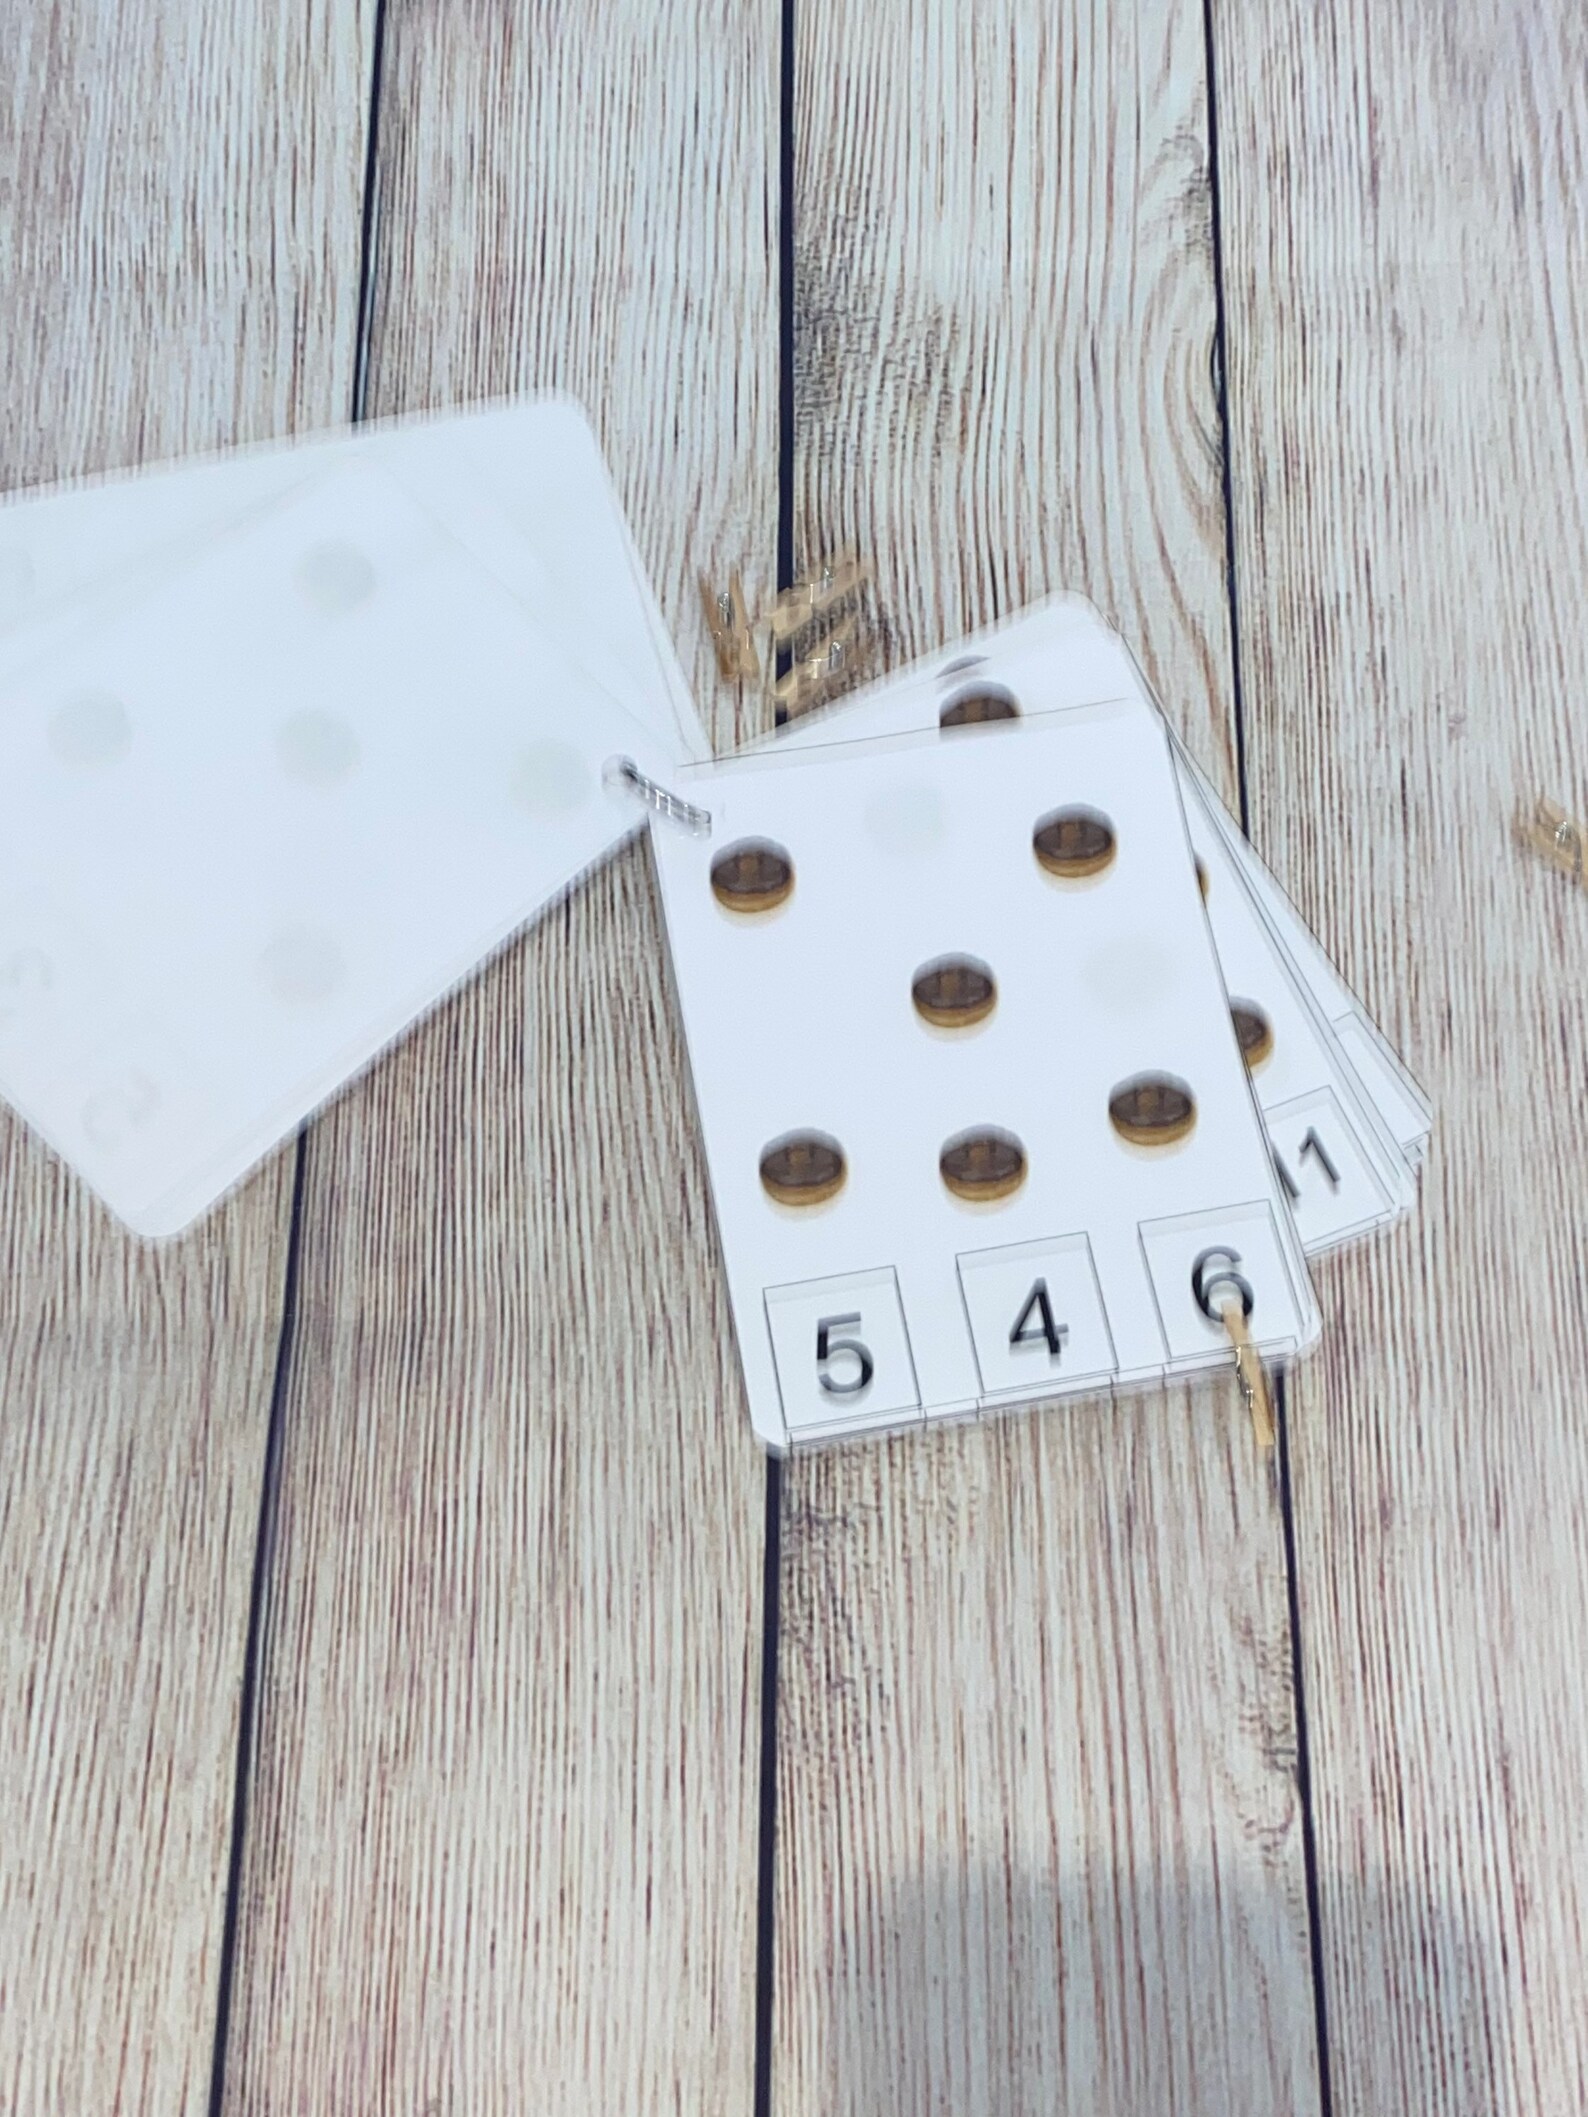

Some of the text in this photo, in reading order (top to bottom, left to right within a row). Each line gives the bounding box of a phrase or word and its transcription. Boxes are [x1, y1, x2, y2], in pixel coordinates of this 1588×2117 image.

[817, 1245, 1254, 1394] 5 4 6
